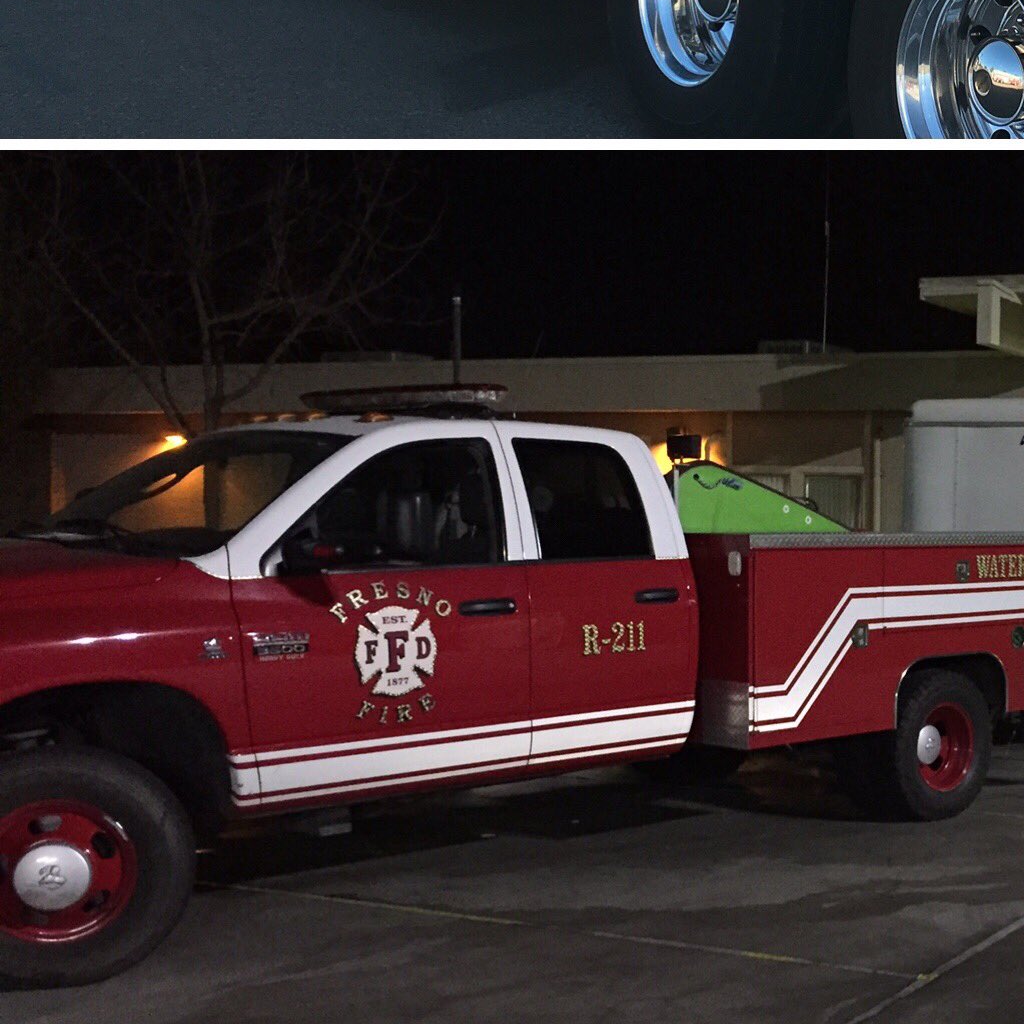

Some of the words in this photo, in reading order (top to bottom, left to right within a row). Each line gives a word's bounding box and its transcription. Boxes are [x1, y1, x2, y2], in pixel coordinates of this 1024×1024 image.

[329, 580, 452, 624] FRESNO
[582, 620, 646, 655] R-211
[387, 677, 409, 687] 1877
[356, 693, 436, 724] FIRE
